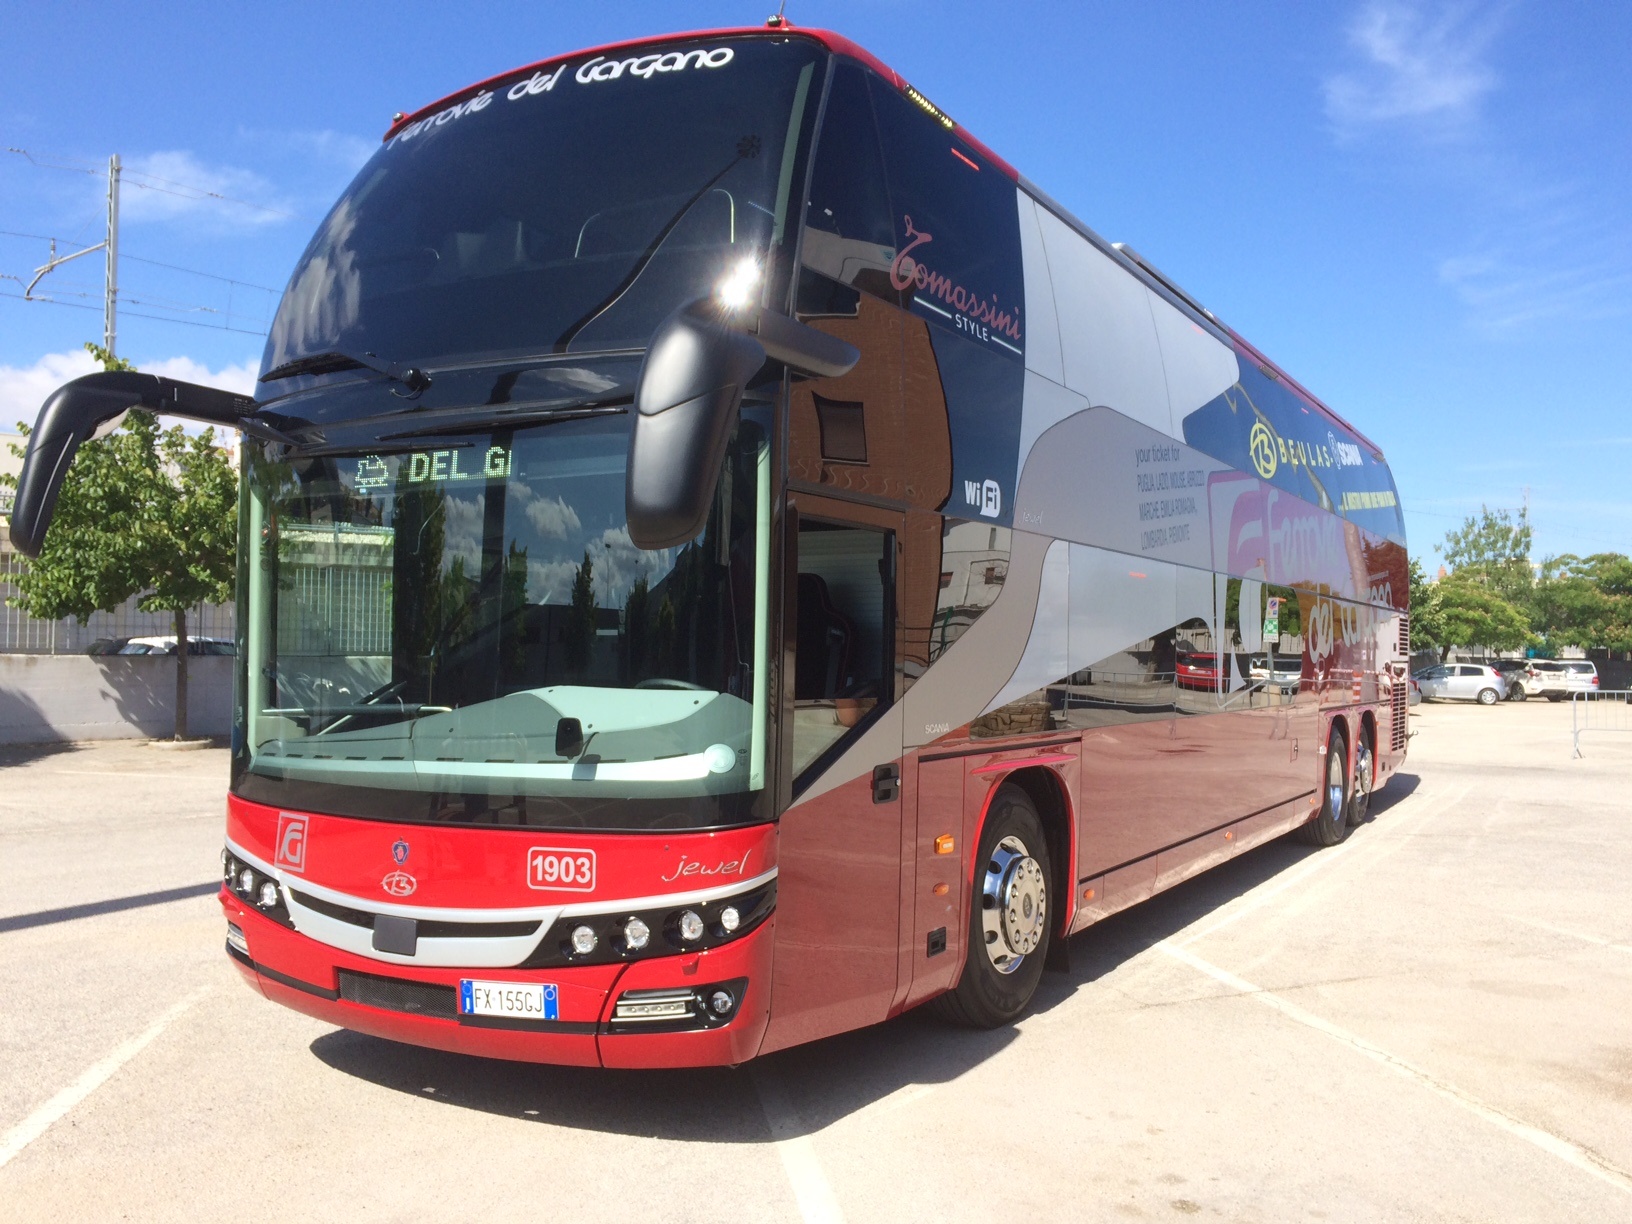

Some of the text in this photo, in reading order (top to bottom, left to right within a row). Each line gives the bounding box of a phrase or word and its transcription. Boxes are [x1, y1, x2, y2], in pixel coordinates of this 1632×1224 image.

[507, 64, 567, 100] del
[575, 47, 734, 83] Gargano
[890, 215, 1021, 340] Tomassini
[955, 314, 988, 342] STYLE
[409, 451, 468, 482] DEL
[1135, 444, 1180, 468] your ticket for
[925, 723, 950, 734] SCANIA
[532, 855, 591, 883] 1903
[661, 849, 752, 882] jewel
[475, 988, 491, 1009] FX
[499, 990, 542, 1012] 155GJ
